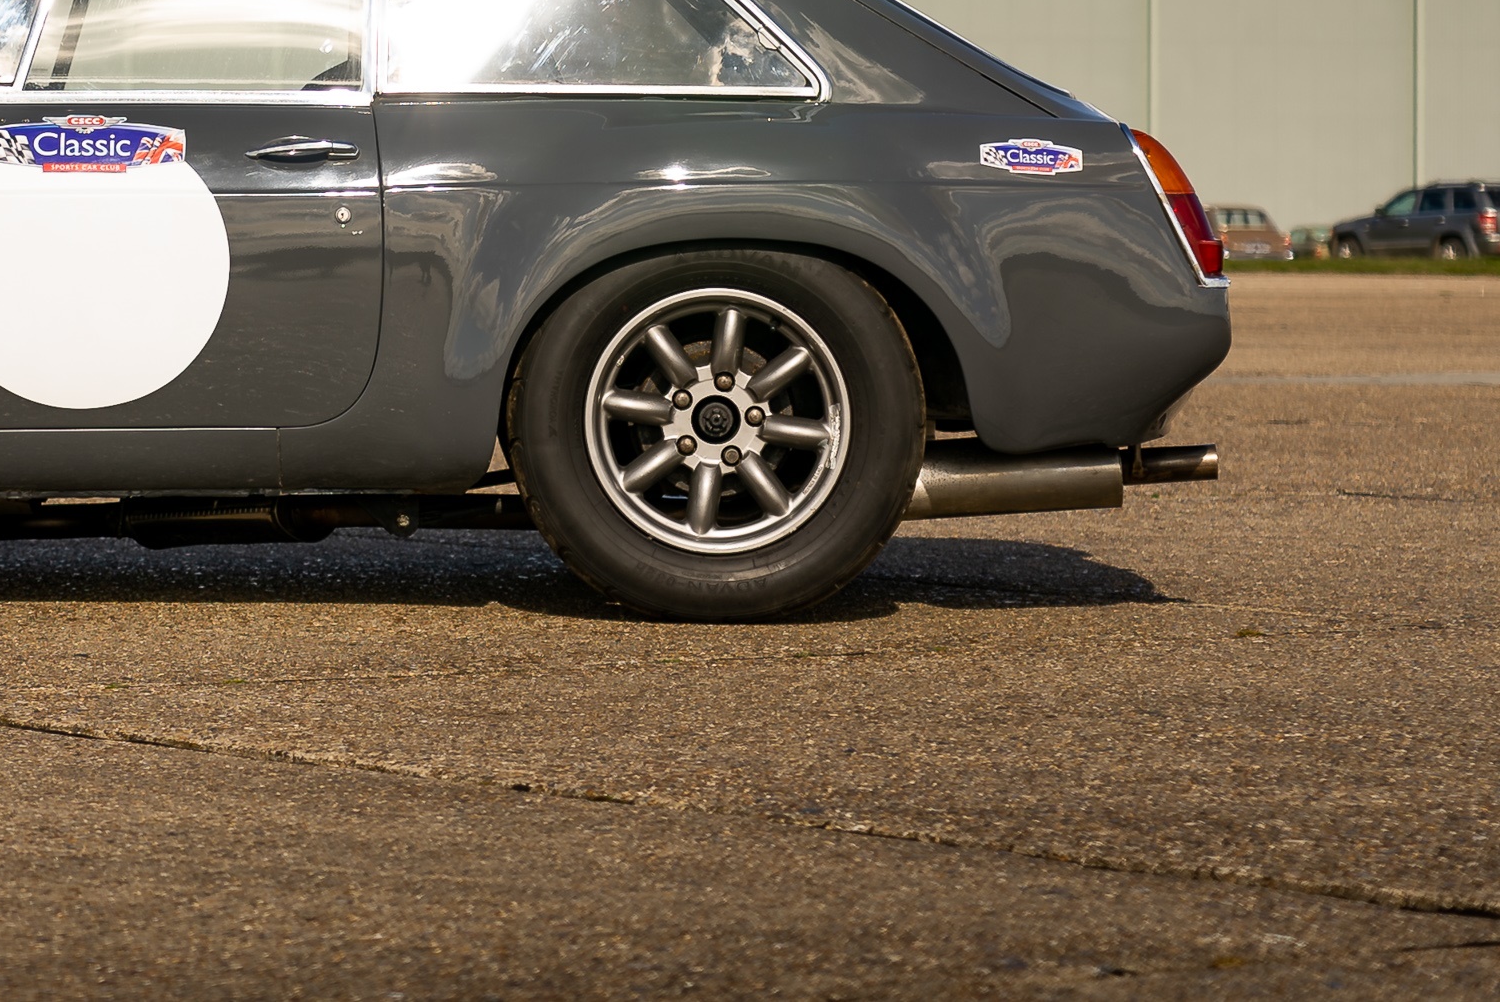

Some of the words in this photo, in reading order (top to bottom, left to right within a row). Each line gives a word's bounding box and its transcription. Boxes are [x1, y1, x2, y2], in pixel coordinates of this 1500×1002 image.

[70, 117, 100, 125] CSCC
[33, 132, 131, 157] Classic
[1006, 149, 1055, 165] Classic
